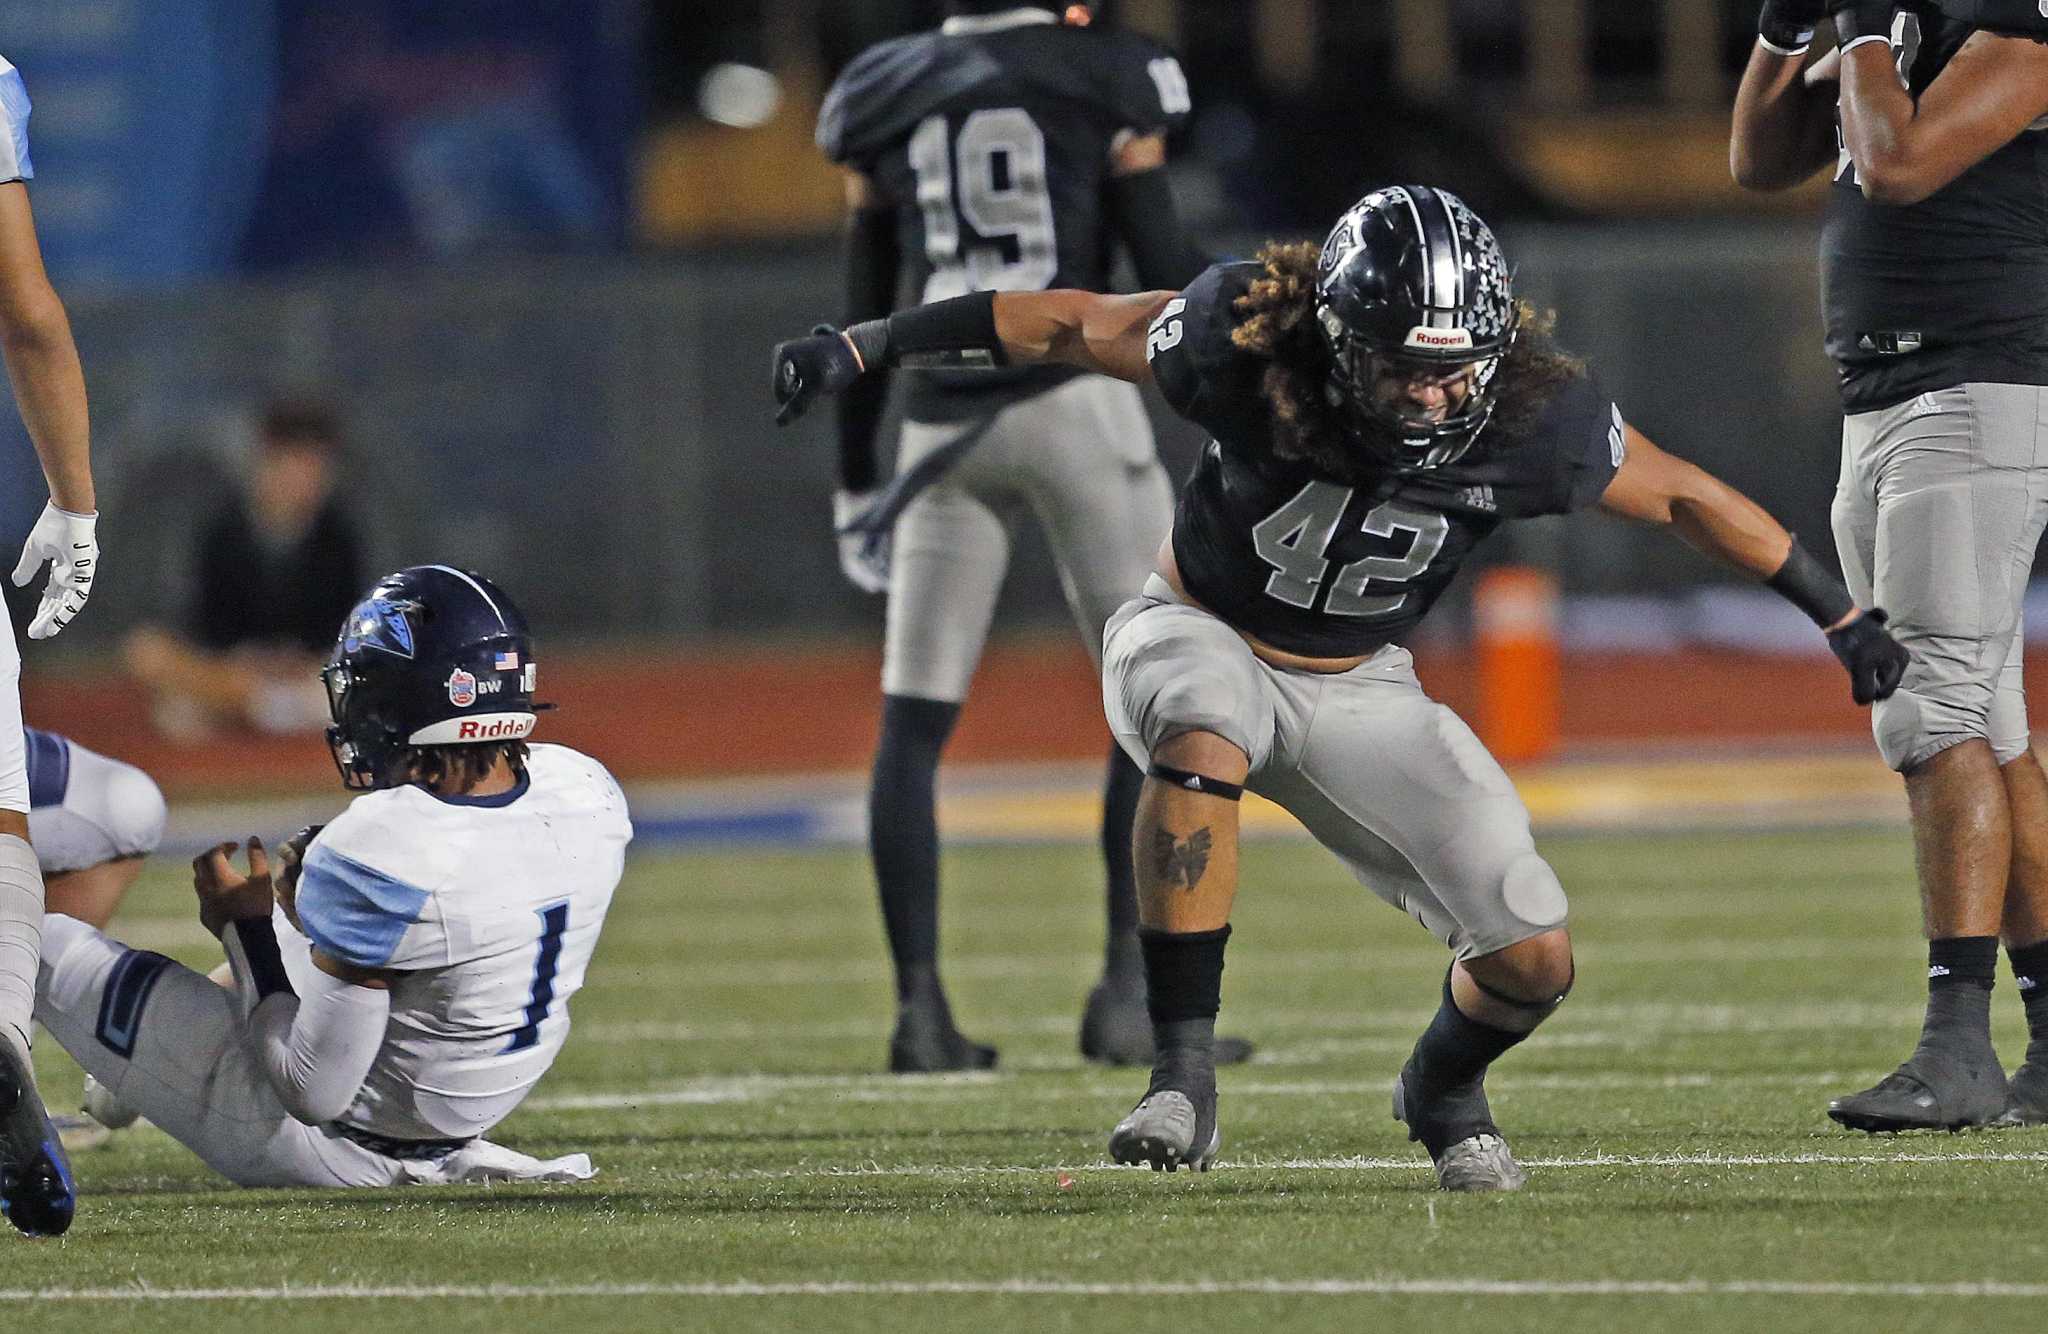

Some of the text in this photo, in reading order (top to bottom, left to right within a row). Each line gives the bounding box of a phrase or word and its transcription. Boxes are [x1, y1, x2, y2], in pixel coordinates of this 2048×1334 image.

[908, 106, 1058, 304] 19
[1416, 332, 1466, 345] Riddell
[52, 542, 92, 630] JORDAN
[1252, 480, 1449, 617] 42
[459, 719, 533, 740] Riddell
[477, 680, 502, 694] BW
[495, 895, 570, 1057] 1
